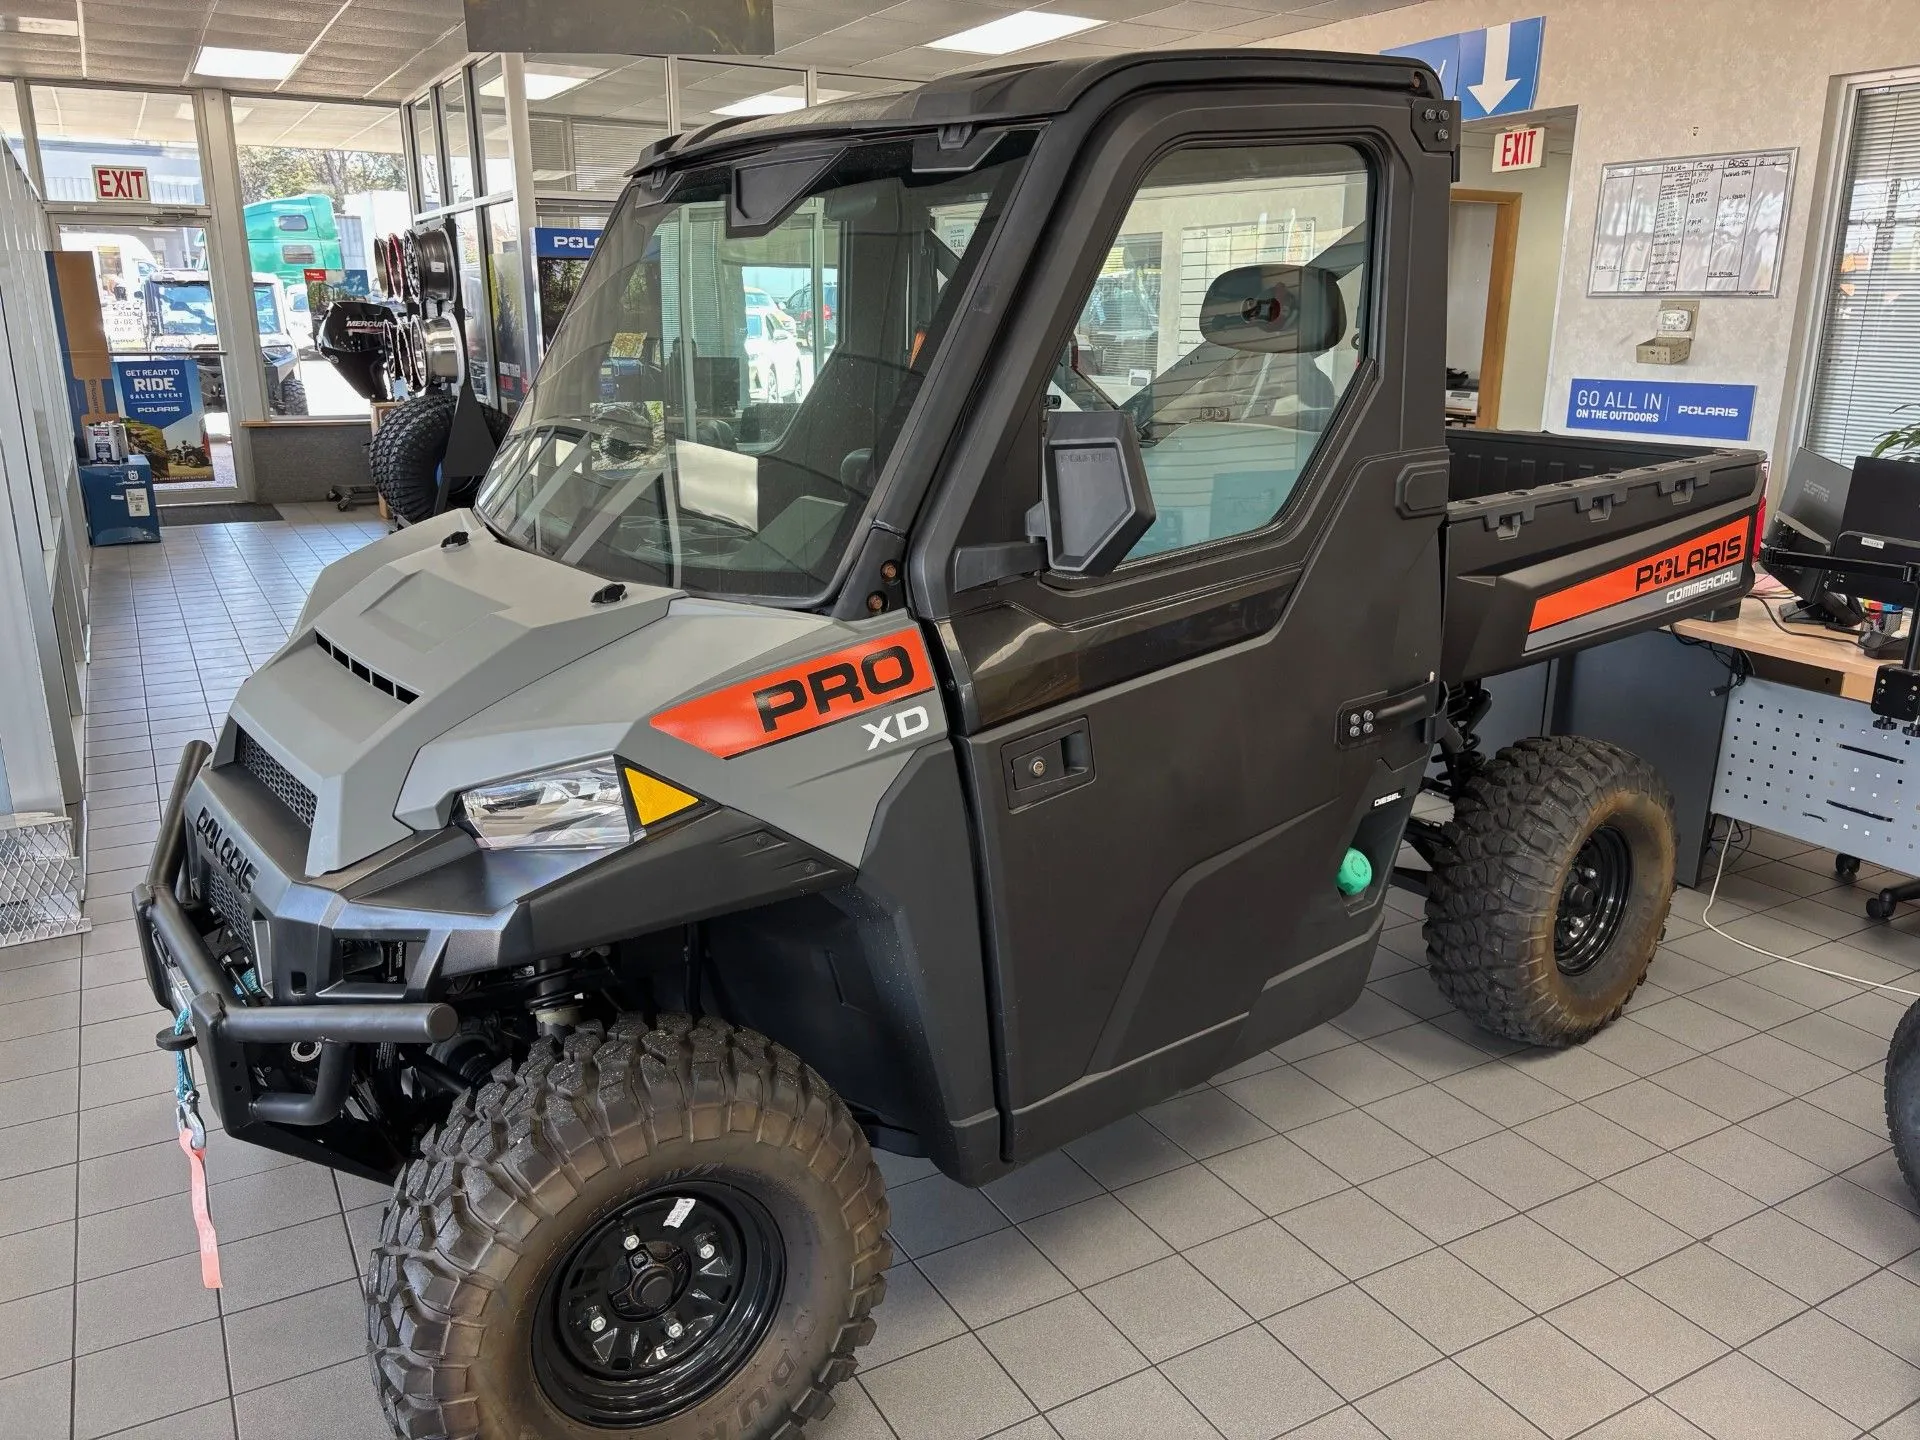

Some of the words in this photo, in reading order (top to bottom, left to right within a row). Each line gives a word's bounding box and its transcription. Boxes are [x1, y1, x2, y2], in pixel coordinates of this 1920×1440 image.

[1501, 130, 1537, 167] EXIT
[97, 169, 144, 199] EXIT
[125, 369, 142, 377] GET
[142, 368, 167, 377] READY
[168, 368, 180, 376] TO
[133, 377, 176, 392] RIDE
[137, 405, 181, 414] POLARIS
[1577, 389, 1600, 407] GO
[1604, 391, 1638, 409] ALL
[1643, 392, 1662, 410] IN
[1677, 405, 1739, 417] POLARIS
[1576, 409, 1589, 419] ON
[1590, 410, 1608, 419] THE
[1609, 411, 1659, 423] OUTDOORS
[1635, 535, 1742, 592] POLARIS
[1666, 570, 1738, 604] COMMERCIAL
[752, 645, 915, 733] PRO
[860, 705, 929, 751] XD
[1374, 792, 1402, 807] DIESEL
[196, 806, 260, 894] POLARIS
